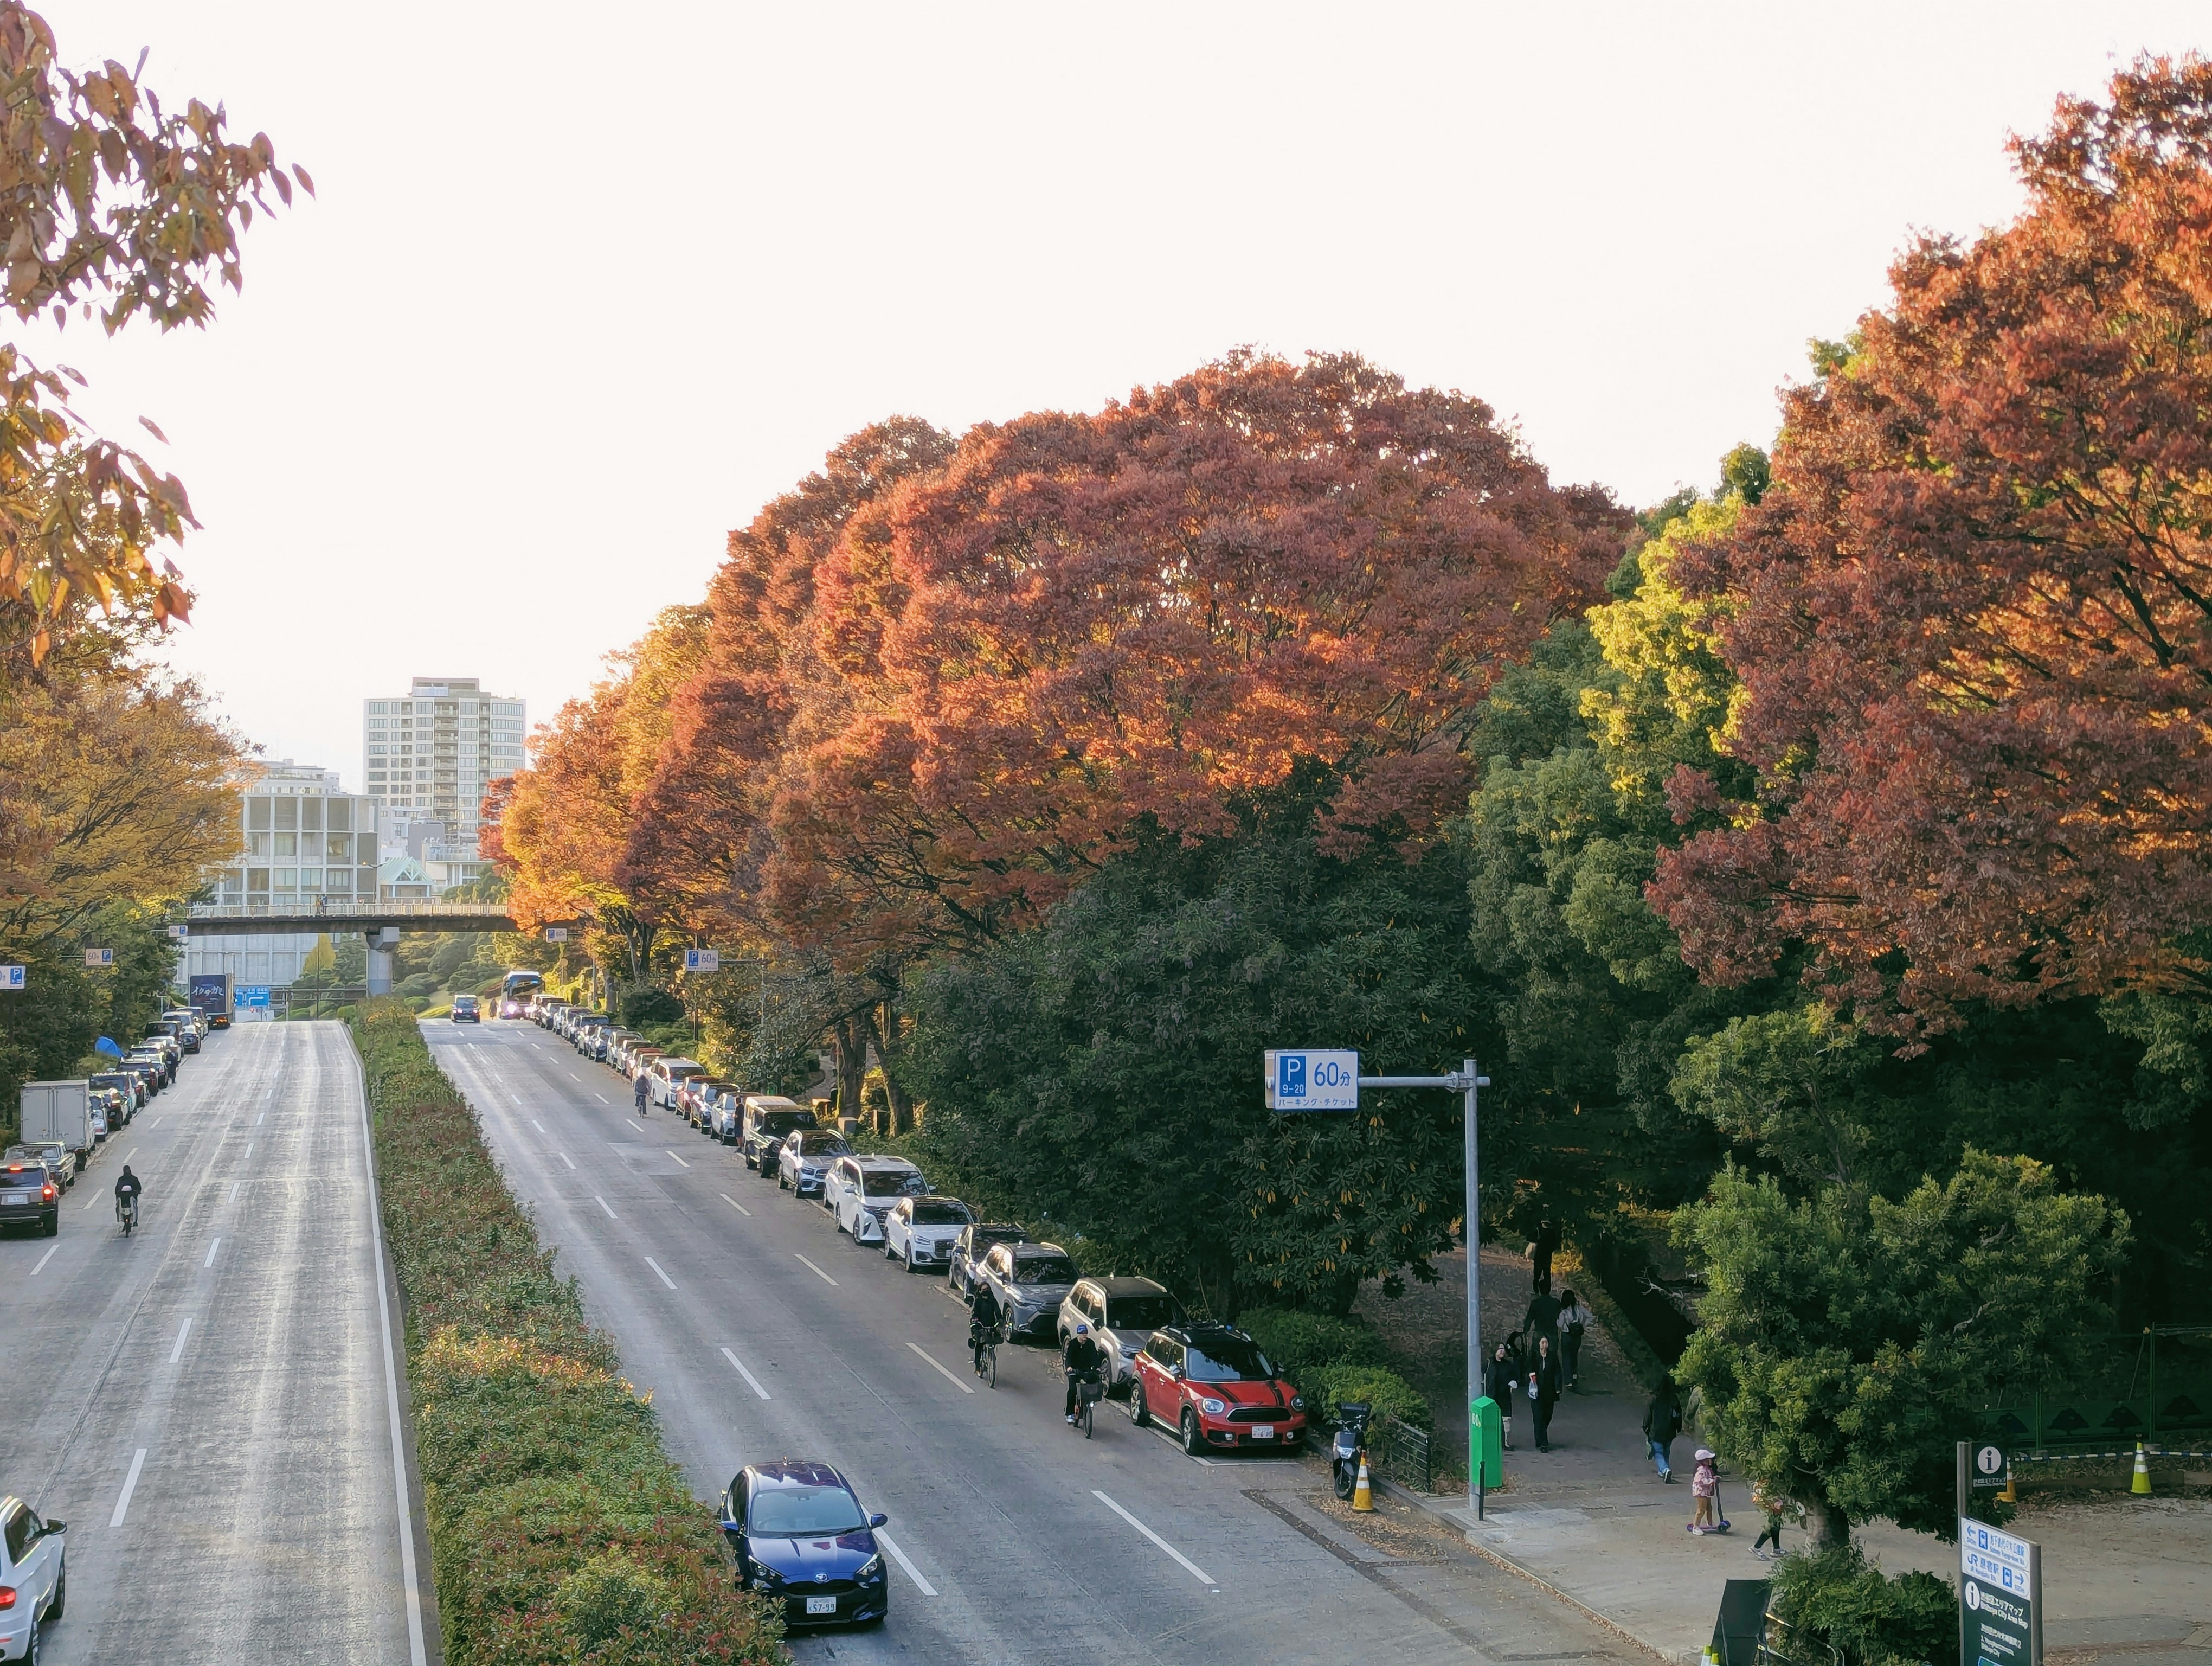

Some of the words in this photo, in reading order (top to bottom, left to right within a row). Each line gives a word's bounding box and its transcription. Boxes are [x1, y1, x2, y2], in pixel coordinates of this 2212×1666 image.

[691, 952, 697, 962] P
[14, 969, 21, 979] P
[1288, 1058, 1301, 1082] P
[1314, 1062, 1351, 1086] 60分
[1282, 1084, 1304, 1094] 9-20
[1278, 1098, 1355, 1107] パーキング・チケット
[1967, 1554, 1978, 1567] JR
